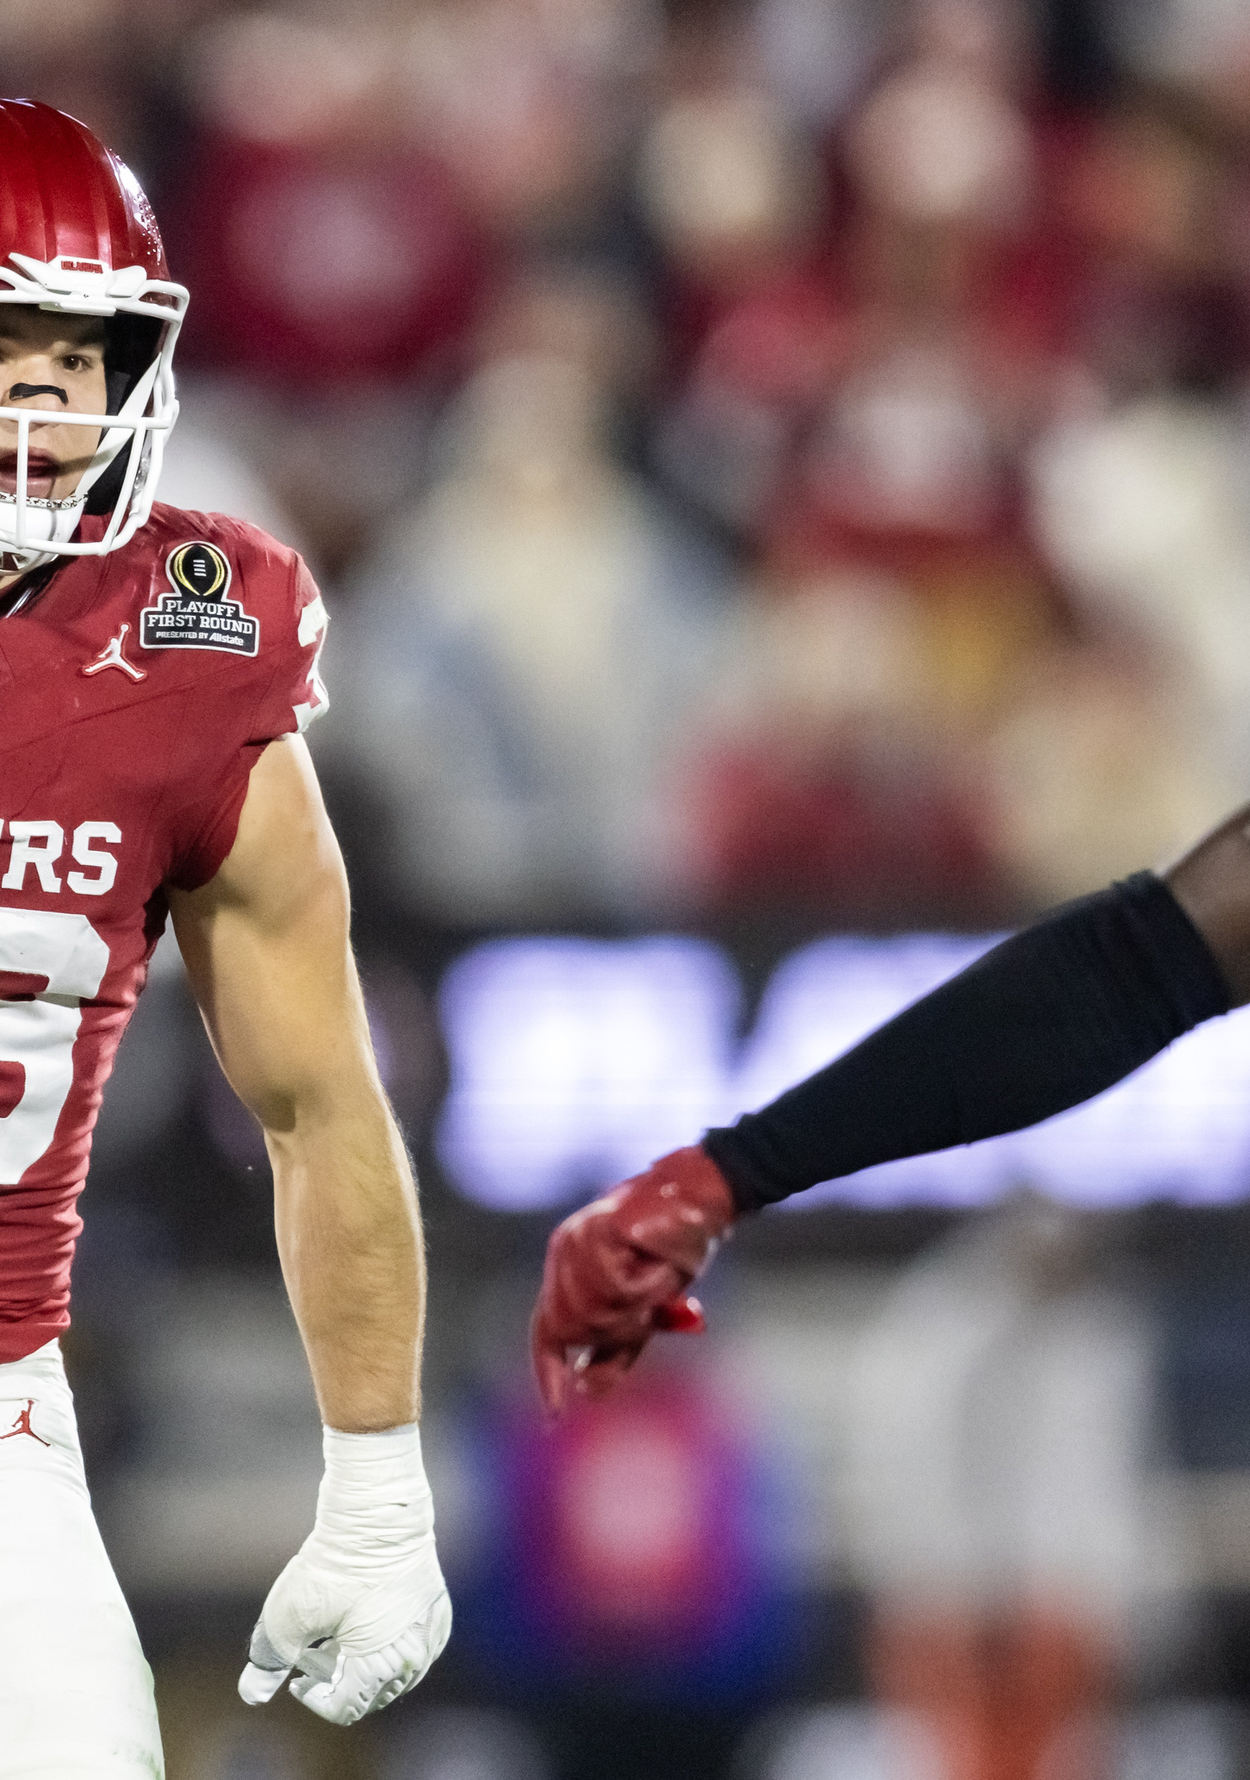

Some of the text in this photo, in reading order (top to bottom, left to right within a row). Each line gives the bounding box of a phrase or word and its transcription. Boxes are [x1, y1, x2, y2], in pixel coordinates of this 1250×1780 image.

[166, 600, 236, 617] PLAYOFF
[147, 614, 253, 634] FIRST ROUND
[155, 630, 198, 639] PRESENTED
[209, 632, 245, 646] Allstate
